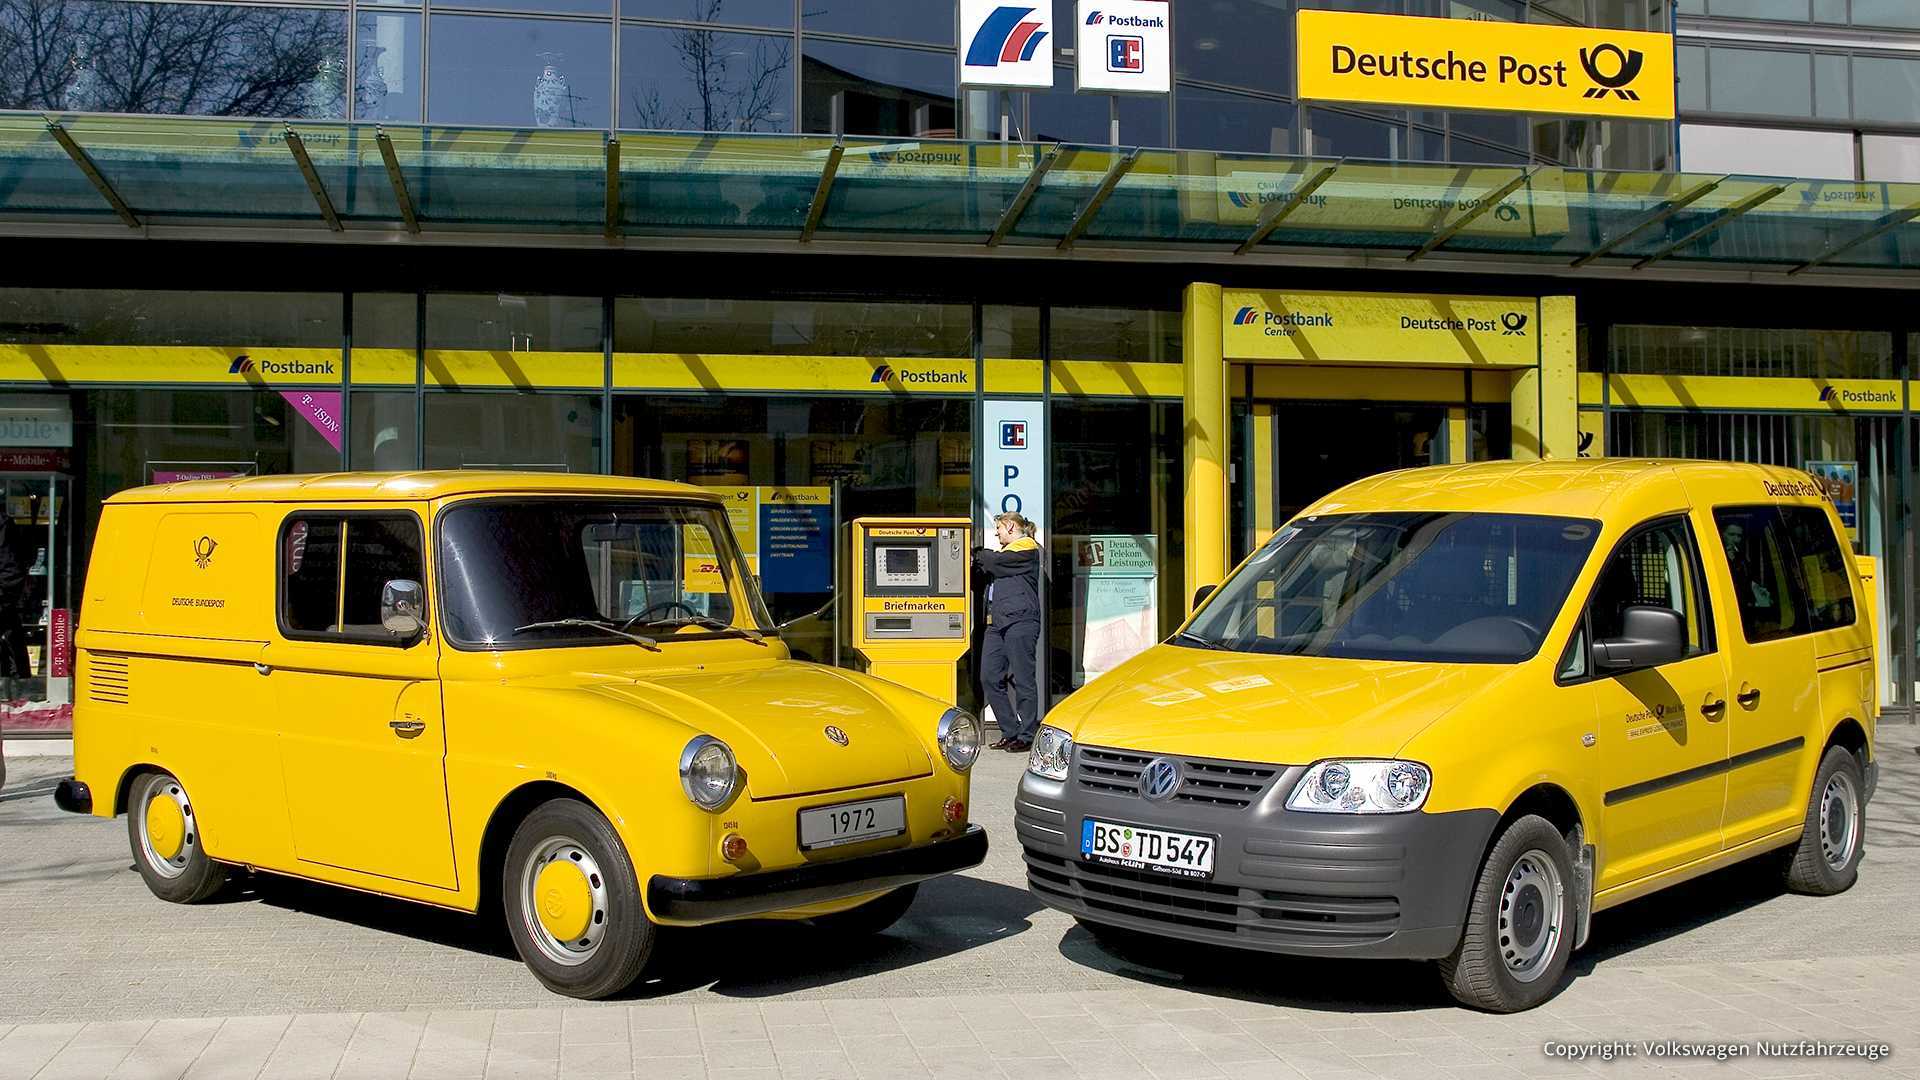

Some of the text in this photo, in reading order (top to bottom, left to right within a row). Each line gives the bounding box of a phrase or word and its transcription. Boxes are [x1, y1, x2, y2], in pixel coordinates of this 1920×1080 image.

[1109, 15, 1164, 28] Postbank
[1331, 45, 1568, 88] Deutsche Post
[1264, 311, 1333, 327] Postbank
[1401, 316, 1497, 331] Deutsche Post
[1264, 327, 1297, 337] Center
[261, 360, 335, 374] Postbank
[900, 370, 967, 384] Postbank
[1842, 390, 1897, 402] Postbank
[1763, 479, 1800, 497] Deutsche
[1798, 481, 1818, 497] Post
[1109, 540, 1145, 549] Deutsche
[1109, 549, 1142, 558] Telekom
[1109, 558, 1154, 568] Leistungen
[884, 601, 946, 611] Briefmarken
[830, 807, 876, 835] 1972
[1093, 826, 1121, 854] BS
[1136, 832, 1162, 861] TD
[1166, 836, 1210, 866] 547
